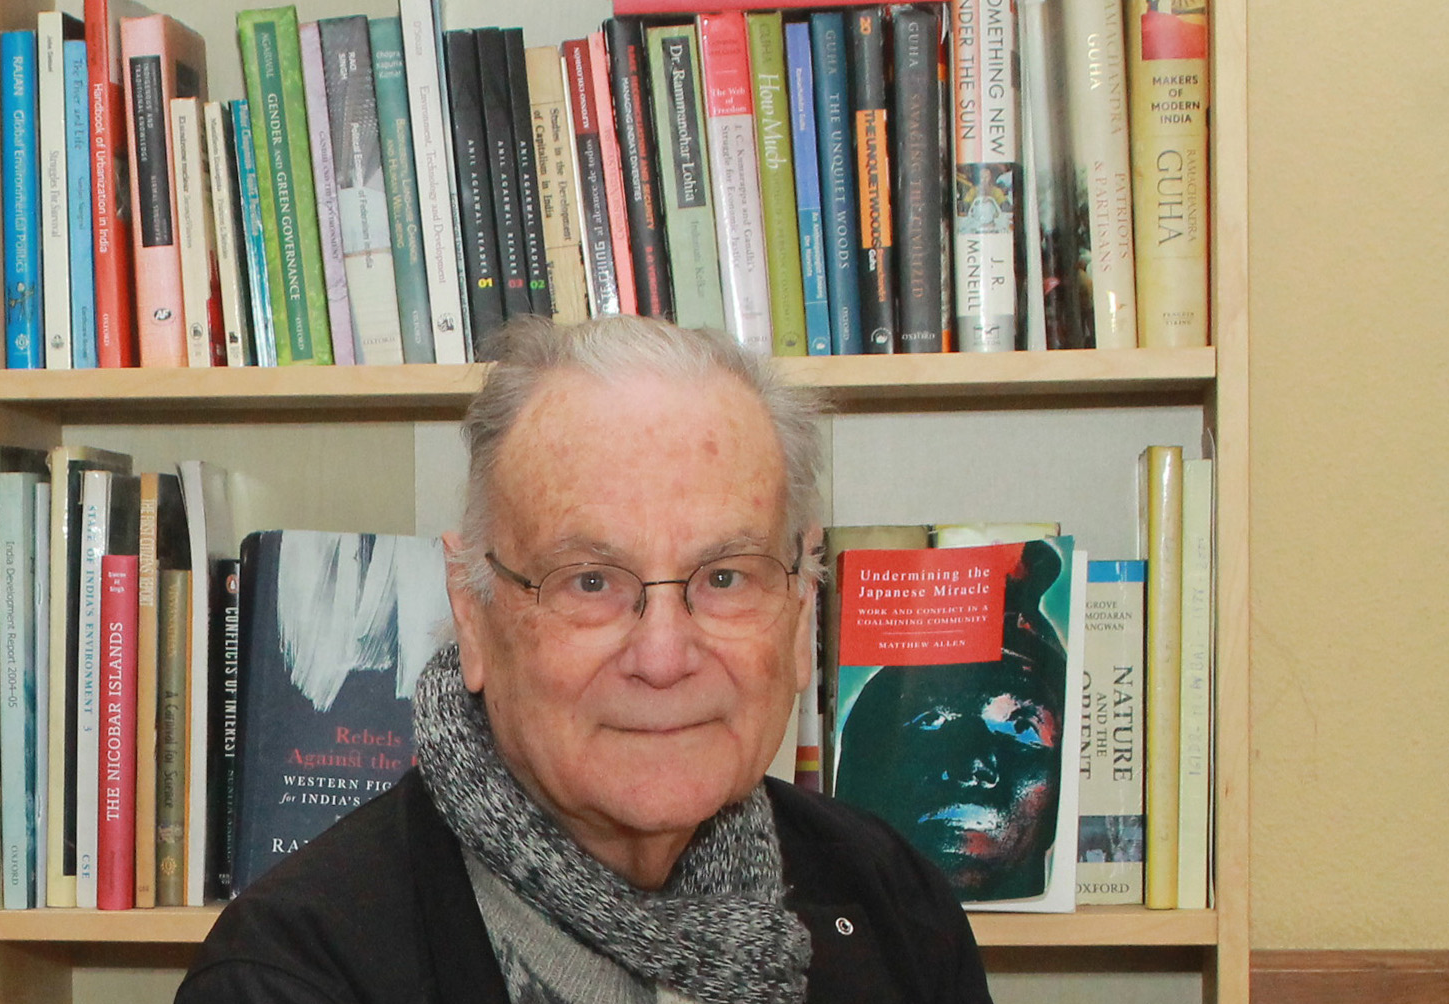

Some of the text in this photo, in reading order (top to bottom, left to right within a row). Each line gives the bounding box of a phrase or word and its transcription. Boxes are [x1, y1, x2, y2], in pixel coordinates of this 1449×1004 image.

[261, 32, 274, 79] AGARWAL
[348, 51, 357, 71] RAO
[824, 29, 838, 75] GUHA
[907, 21, 920, 68] GUHA
[1087, 32, 1103, 90] GUHA
[72, 58, 84, 77] The
[338, 52, 349, 80] SINGH
[959, 55, 975, 91] THE
[1152, 74, 1199, 86] MAKERS
[712, 87, 746, 97] The Web
[714, 104, 747, 115] Freedom
[757, 73, 780, 116] How
[1151, 101, 1201, 112] MODERN
[1168, 88, 1183, 98] OF
[74, 109, 85, 128] and
[145, 112, 155, 129] AND
[670, 44, 698, 203] Dr. Rammanohar Lohia
[961, 99, 976, 141] SUN
[990, 107, 1006, 156] NEW
[1160, 113, 1193, 124] INDIA
[74, 130, 85, 151] Life
[621, 77, 642, 202] MANAGING INDIA'S DIVERSITIES
[761, 117, 787, 170] Much
[12, 56, 28, 273] RAJAN Global Environmental Politics
[94, 83, 110, 254] Handbook of Urbanization in India
[387, 157, 400, 194] HUMAN
[424, 149, 439, 203] Technology
[533, 110, 554, 219] of Capitalism in India
[549, 107, 572, 242] Studies in the Development
[829, 92, 850, 270] THE UNQUIET WOODS
[267, 93, 301, 301] GENDER AND GREEN GOVERNANCE
[431, 204, 441, 221] and
[467, 139, 488, 275] ANIL AGARWAL READER
[497, 140, 518, 276] ANIL AGARWAL READER
[519, 141, 541, 276] ANIL AGARWAL READER
[1156, 149, 1185, 247] GUHA
[1187, 148, 1199, 242] RAMACHANDRA
[391, 195, 406, 249] WELL-BEING
[1094, 176, 1113, 273] PARTISANS
[1114, 172, 1130, 260] PATRIOTS
[430, 223, 448, 284] Development
[867, 248, 878, 271] Guha
[991, 256, 1005, 290] J. R.
[478, 278, 493, 289] 01
[531, 279, 546, 290] 02
[966, 239, 982, 311] McNEILL
[101, 312, 110, 347] OXFORD
[295, 316, 306, 351] OXFORD
[842, 306, 851, 341] OXFORD
[5, 540, 17, 565] India
[84, 547, 95, 563] OF
[858, 583, 990, 601] Japanese Miracle
[859, 566, 990, 582] Undermining the
[4, 567, 17, 630] Development
[84, 570, 95, 618] INDIA'S
[857, 608, 889, 616] WORK
[892, 607, 914, 616] AND
[916, 606, 964, 614] CONFLICT
[981, 604, 989, 612] A
[856, 615, 988, 627] COALMINING COMMUNITY
[5, 633, 18, 665] Report
[878, 639, 966, 650] MATTHEW ALLEN
[83, 622, 95, 715] ENVIRONMENT
[223, 606, 239, 758] CONFLICTS OF INTEREST
[106, 621, 123, 821] THE NICOBAR ISLANDS
[335, 726, 402, 746] Rebels
[1096, 692, 1108, 758] AND THE
[1113, 664, 1134, 782] NATURE
[163, 690, 178, 809] A Carnival for Science
[287, 748, 364, 769] Against
[371, 752, 402, 770] the
[278, 792, 361, 806] for INDIA'S
[283, 775, 360, 790] WESTERN
[11, 844, 20, 886] OXFORD
[81, 853, 92, 880] CSE
[1076, 883, 1131, 894] OXFORD
